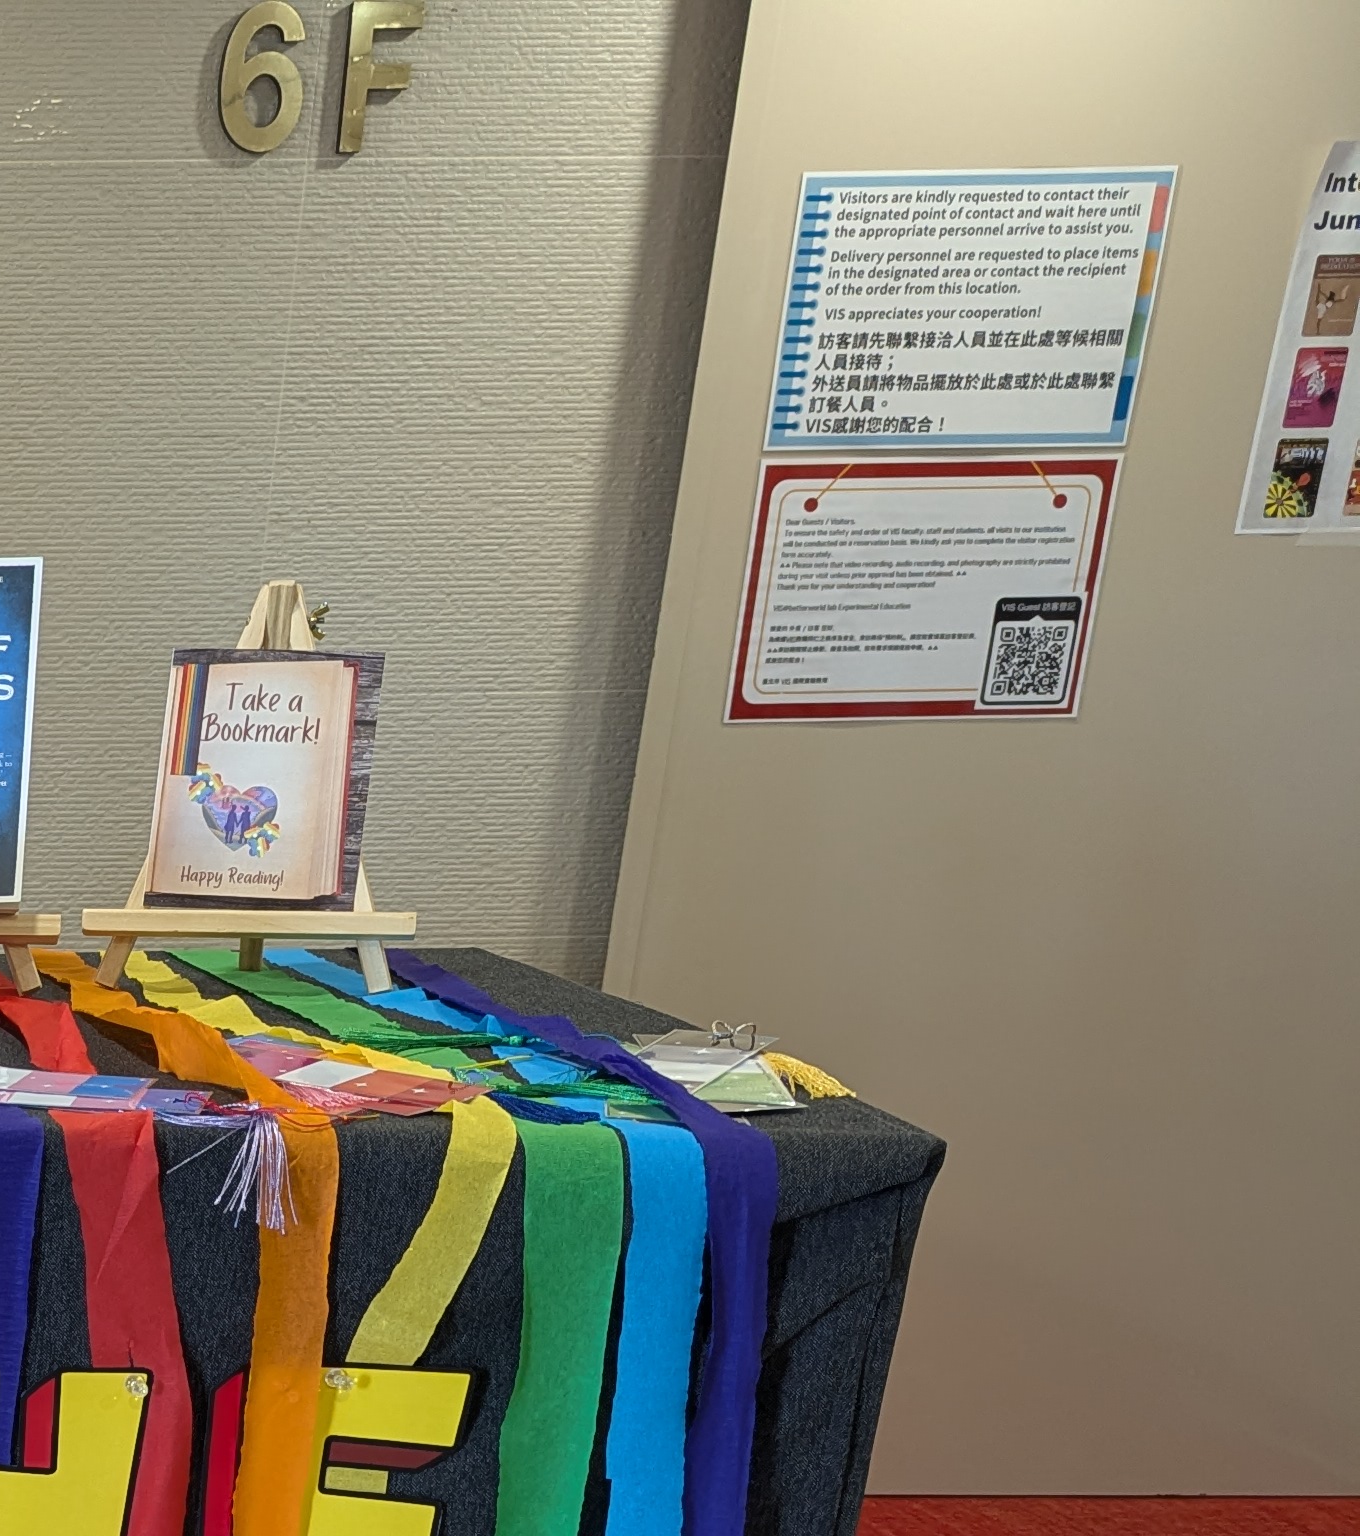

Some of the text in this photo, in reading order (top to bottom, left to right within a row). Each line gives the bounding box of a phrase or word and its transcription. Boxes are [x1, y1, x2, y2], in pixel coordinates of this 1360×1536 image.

[218, 1, 425, 154] 6F
[839, 188, 1130, 207] Visitors are kindly requested to contact their
[825, 305, 1042, 323] VIS appreciates your cooperation!
[226, 682, 303, 713] Take a
[200, 712, 321, 745] Bookmark!
[181, 865, 284, 892] Happy Reading!
